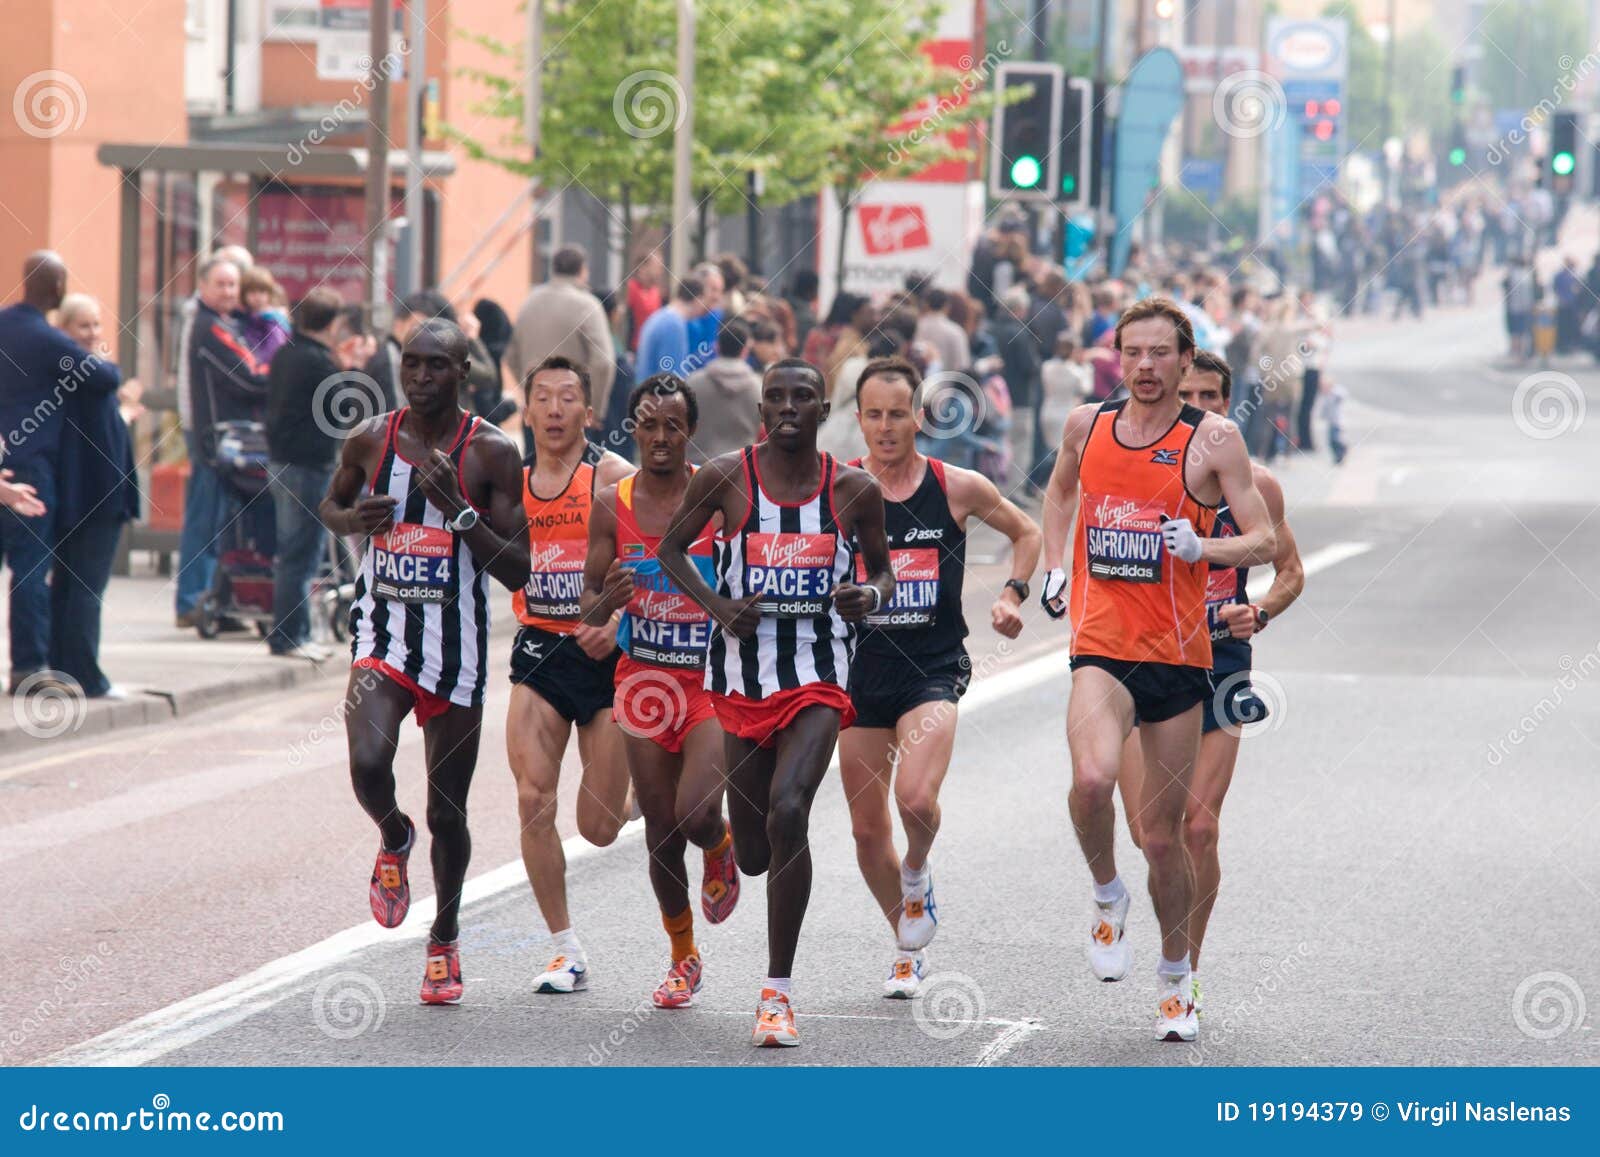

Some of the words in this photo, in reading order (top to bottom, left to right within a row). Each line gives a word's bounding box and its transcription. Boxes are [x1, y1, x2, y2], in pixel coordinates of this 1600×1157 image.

[1095, 495, 1140, 529] Virgin
[528, 512, 585, 529] ONGOLIA
[1122, 519, 1160, 532] money
[383, 522, 428, 554] Virgin
[1089, 528, 1160, 561] SAFRONOV
[412, 544, 449, 556] money
[761, 534, 811, 567] Virgin
[375, 549, 429, 581] PACE
[435, 558, 450, 583] 4
[794, 555, 830, 566] money
[900, 568, 935, 580] money
[1110, 564, 1153, 578] adidas
[749, 567, 810, 596] PACE
[815, 569, 829, 595] 3
[399, 586, 444, 598] adidas
[549, 603, 580, 615] adida
[638, 590, 685, 621] Virgin
[780, 601, 823, 614] adidas
[668, 611, 705, 621] money
[890, 612, 930, 624] adidas
[631, 616, 707, 647] KIFLE
[657, 652, 700, 665] adidas
